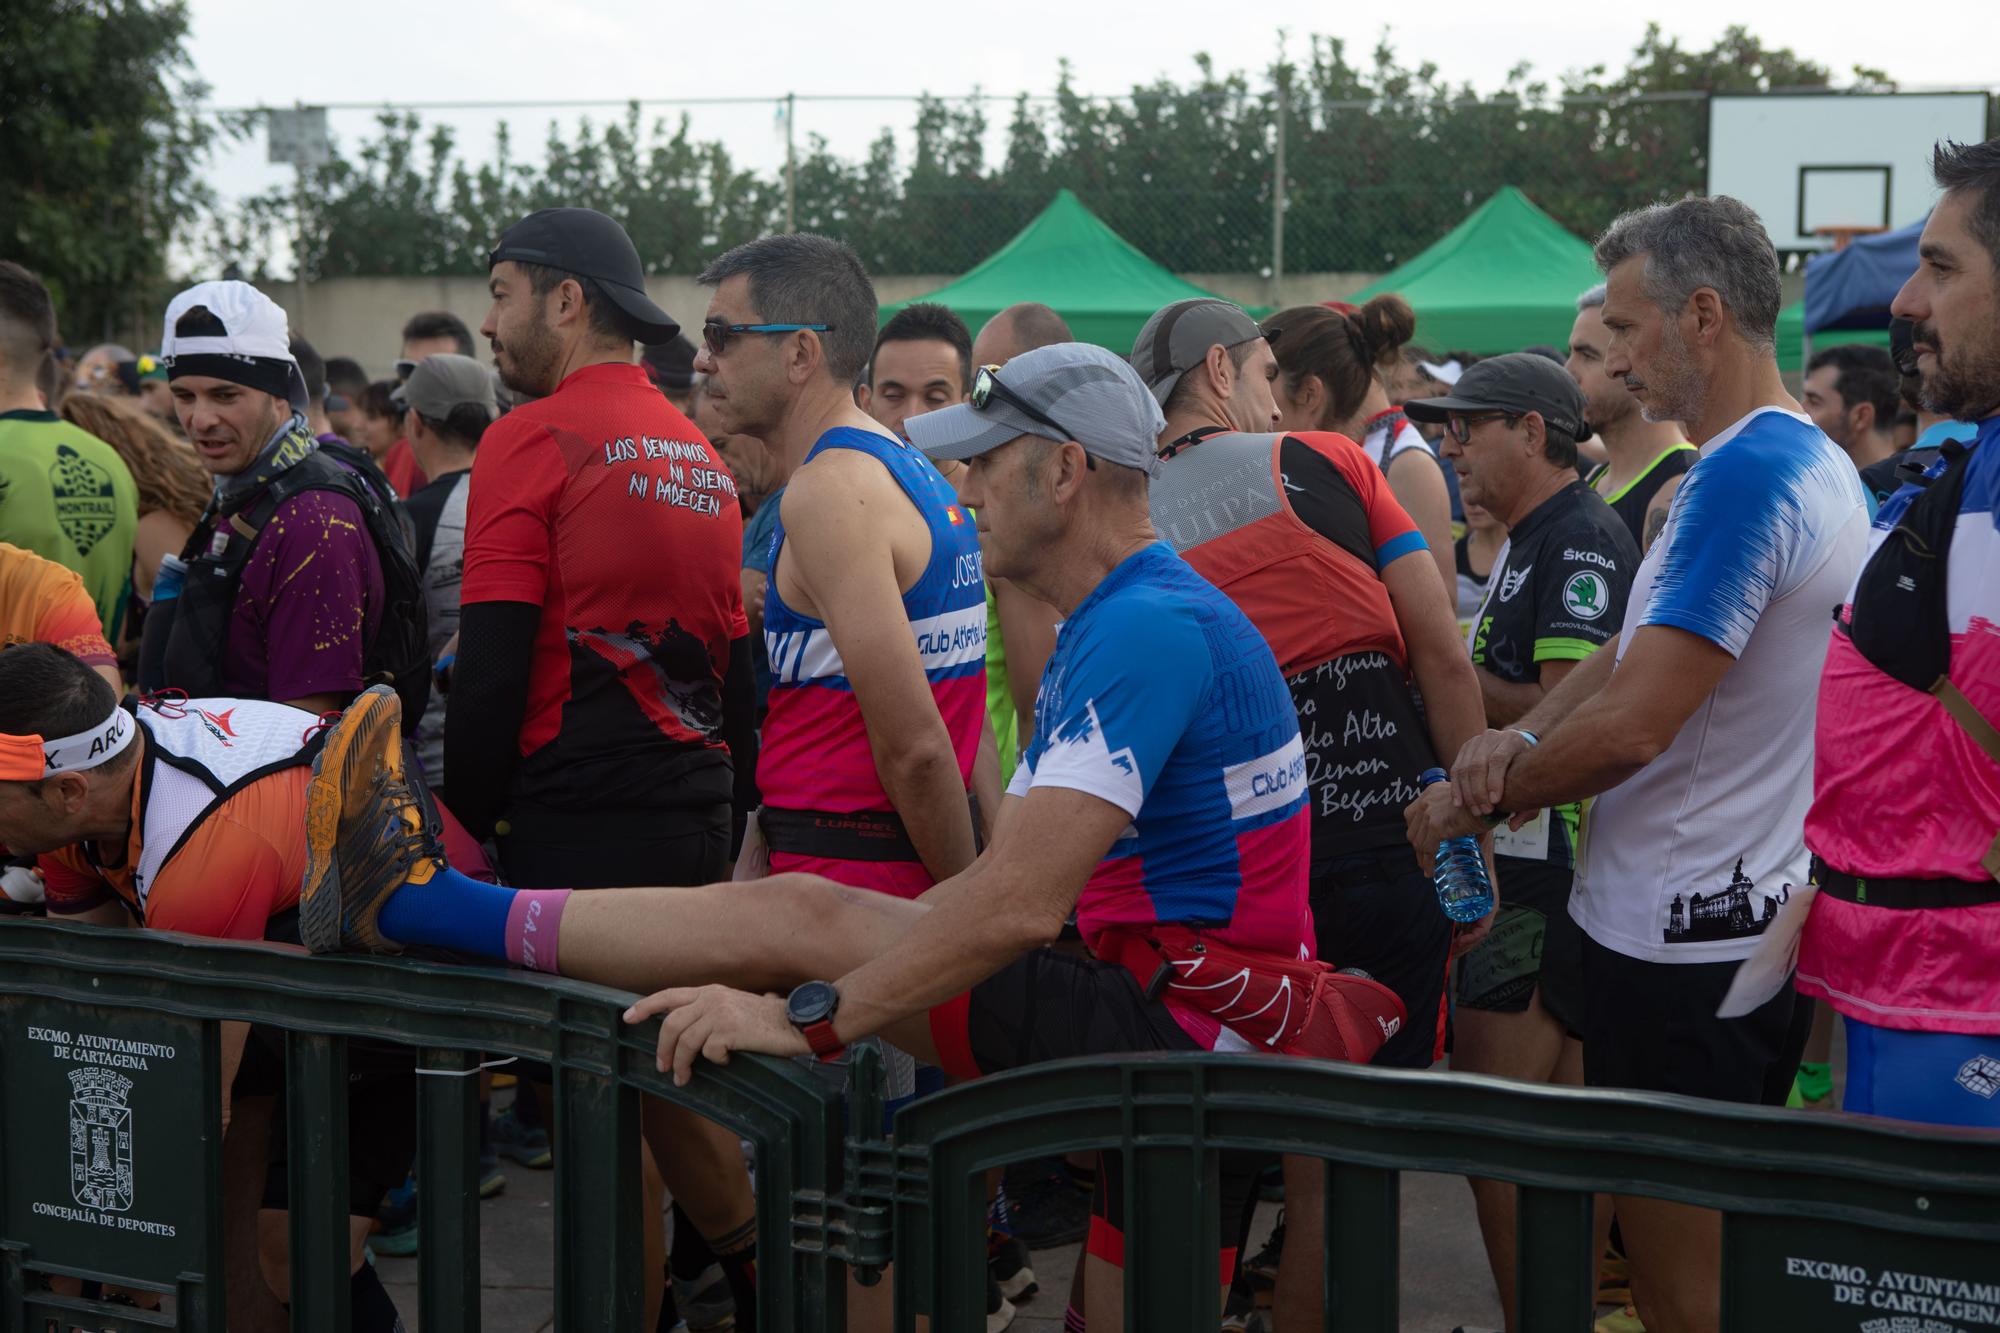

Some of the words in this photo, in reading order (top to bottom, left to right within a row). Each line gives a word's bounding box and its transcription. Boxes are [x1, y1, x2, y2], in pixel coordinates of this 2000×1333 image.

[605, 438, 638, 464] LOS
[642, 434, 709, 463] DEMONIOS
[669, 463, 684, 486] NI
[628, 472, 648, 499] NI
[655, 477, 720, 517] PADECEN
[1563, 548, 1617, 571] ŠKODA
[1344, 709, 1398, 747] Alto
[1252, 767, 1287, 797] Club
[1305, 752, 1389, 786] Zenon
[27, 1026, 73, 1045] EXCMO.
[76, 1033, 176, 1059] AYUNTAMIENTO
[53, 1045, 70, 1060] DE
[72, 1047, 149, 1071] CARTAGENA
[32, 1202, 97, 1224] CONCEJALÍA
[99, 1213, 115, 1227] DE
[117, 1217, 176, 1238] DEPORTES
[1786, 1256, 1872, 1286] EXCMO.
[1834, 1284, 1866, 1306] DE
